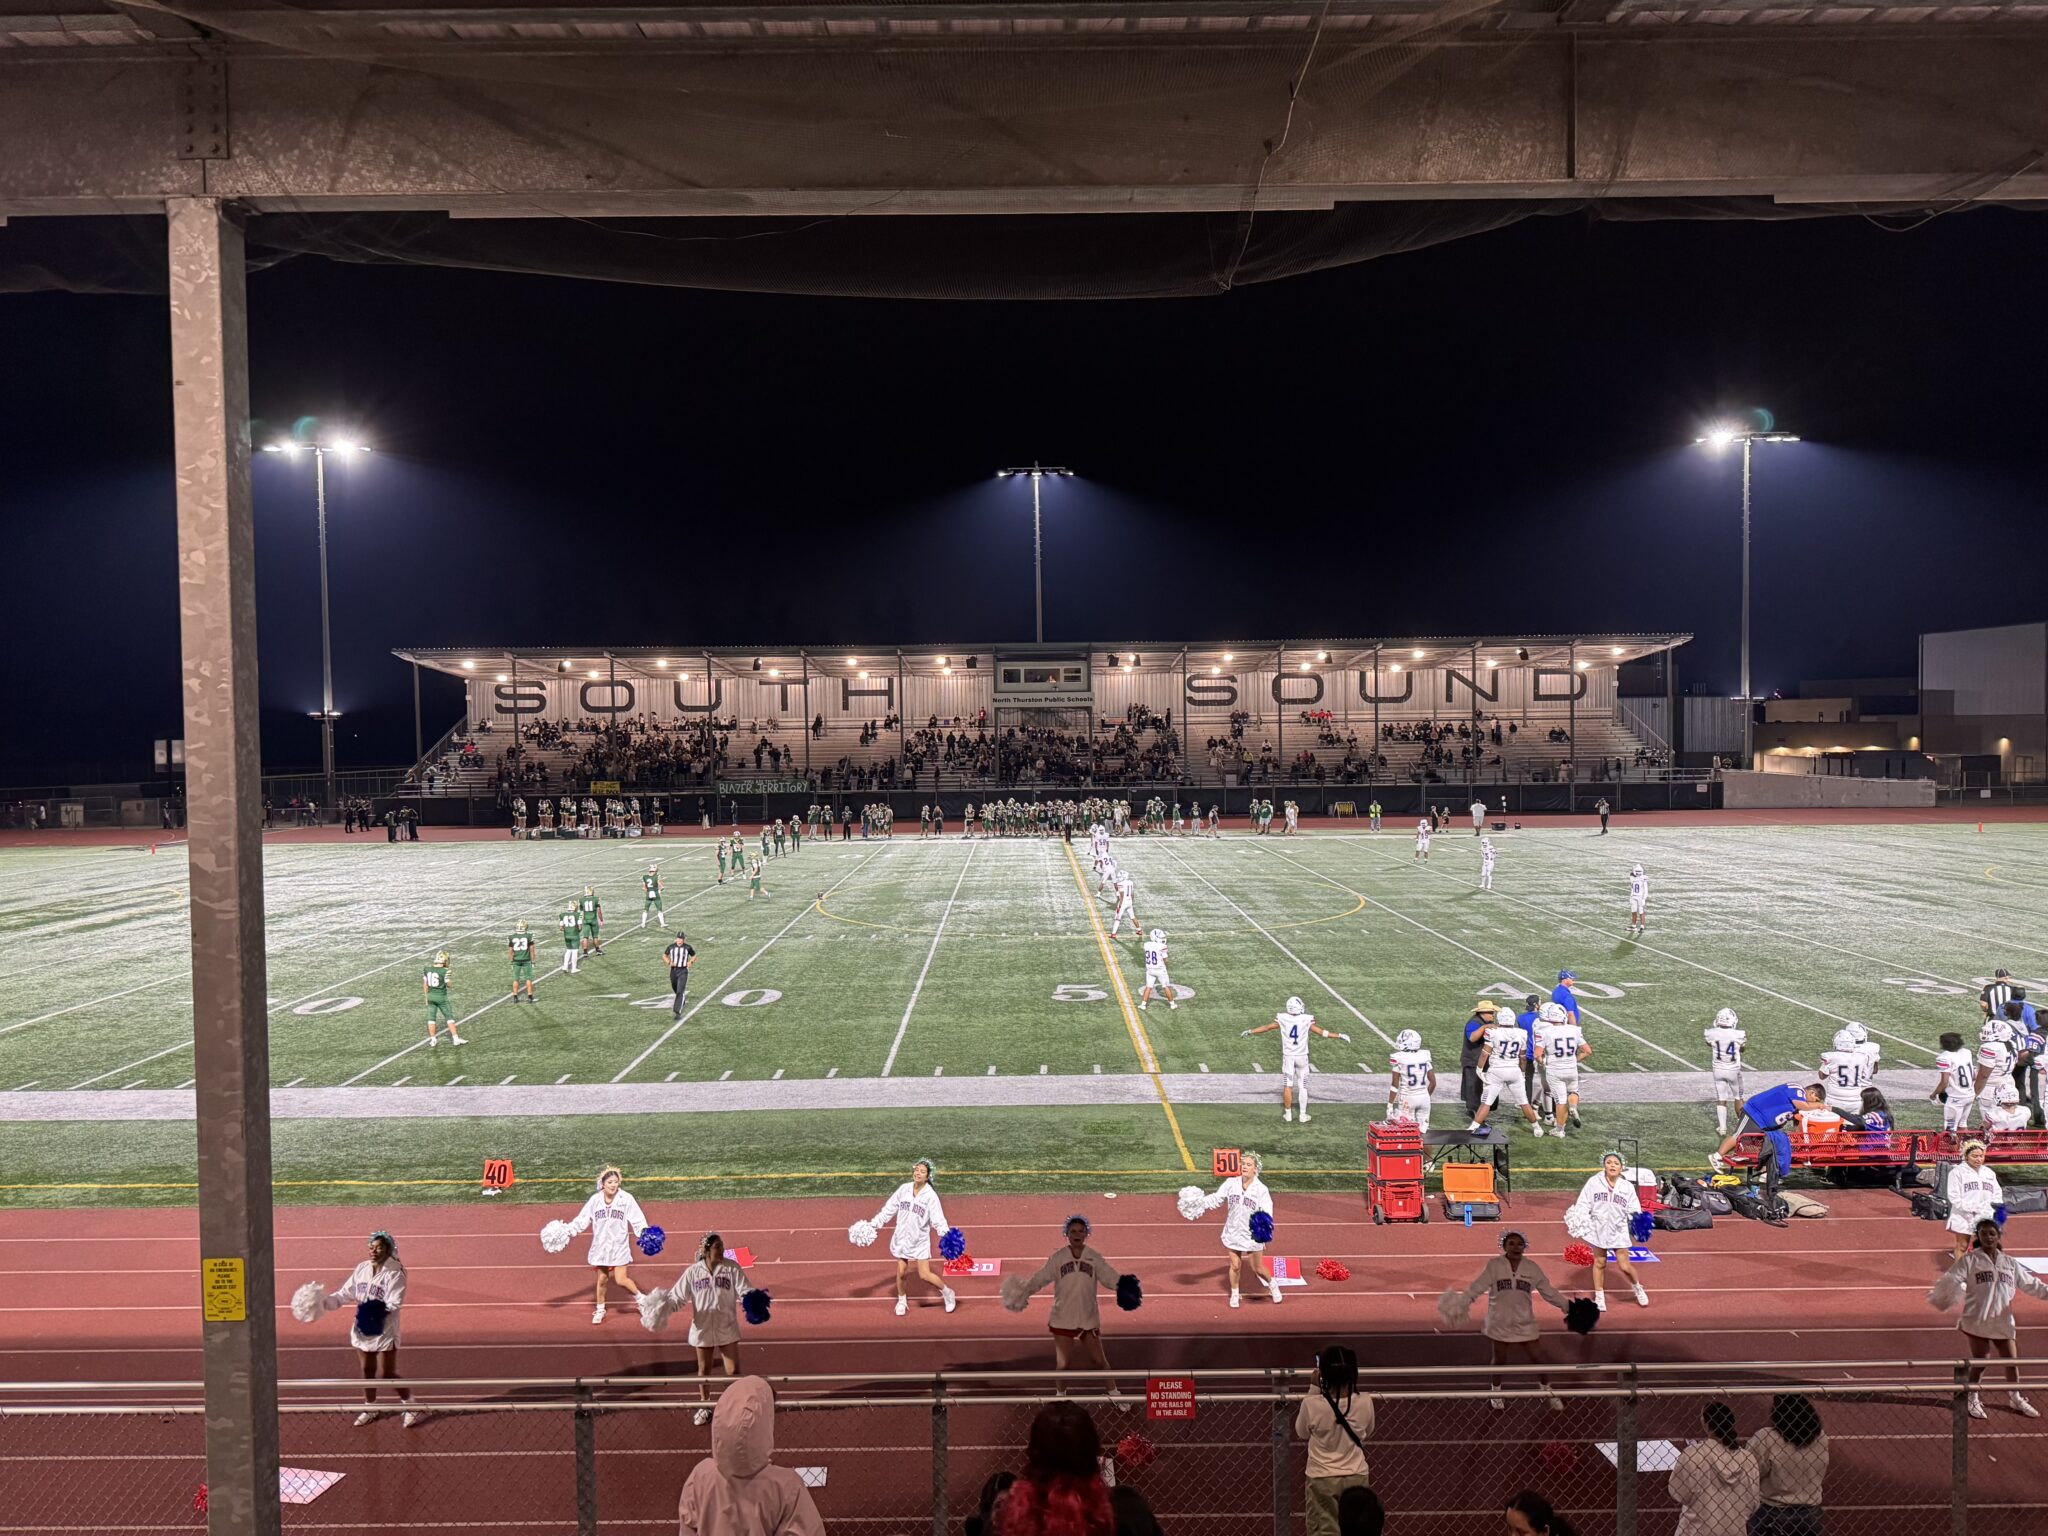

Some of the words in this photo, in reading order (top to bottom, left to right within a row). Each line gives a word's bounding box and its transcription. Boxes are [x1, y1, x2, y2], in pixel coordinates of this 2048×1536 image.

[494, 678, 894, 714] SOUTH
[1187, 669, 1588, 706] SOUND
[720, 783, 752, 794] BLAZER
[756, 781, 808, 794] TERRITORY
[646, 879, 654, 888] 2
[584, 900, 593, 911] 11
[512, 937, 528, 951] 23
[1145, 950, 1158, 966] 28
[427, 971, 439, 987] 16
[1289, 1024, 1299, 1045] 4
[1499, 1040, 1520, 1060] 72
[1554, 1037, 1575, 1058] 55
[1715, 1040, 1736, 1062] 14
[1407, 1063, 1428, 1087] 57
[1838, 1065, 1859, 1087] 51
[1216, 1152, 1238, 1173] 50
[485, 1162, 508, 1185] 40
[1593, 1192, 1628, 1208] PATRIOTS
[594, 1208, 625, 1221] PATRIOTS
[1159, 1381, 1183, 1390] PLEASE
[1150, 1391, 1160, 1400] NO
[1160, 1391, 1192, 1400] STANDING
